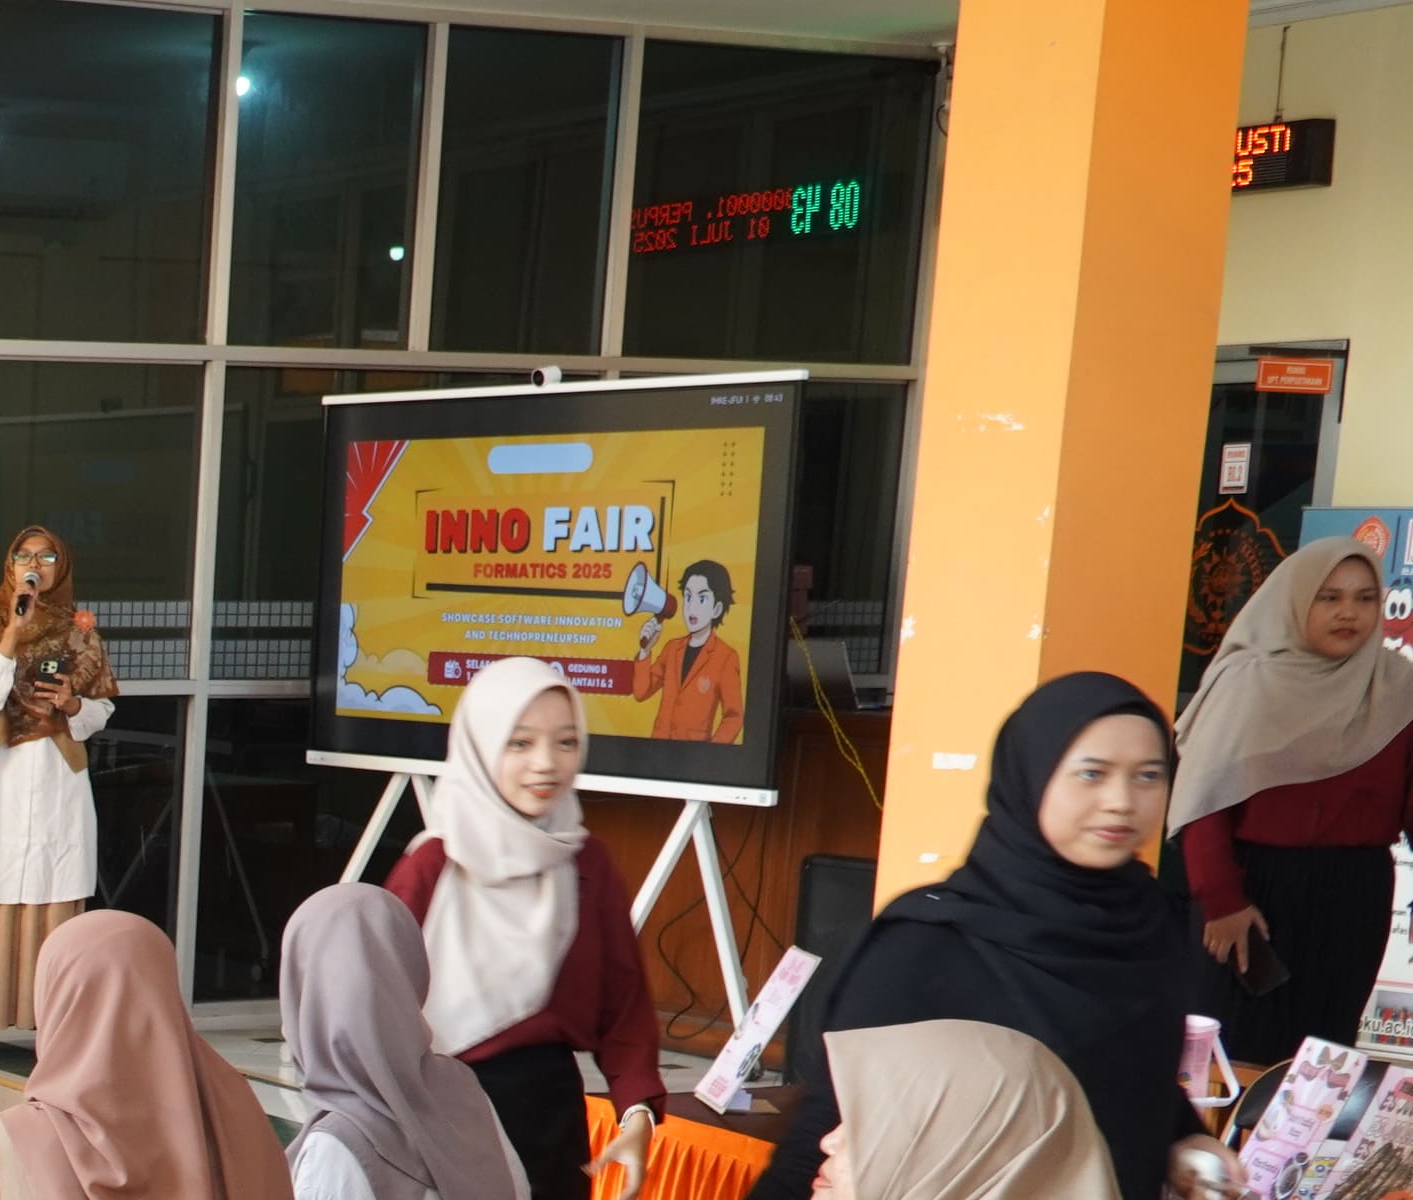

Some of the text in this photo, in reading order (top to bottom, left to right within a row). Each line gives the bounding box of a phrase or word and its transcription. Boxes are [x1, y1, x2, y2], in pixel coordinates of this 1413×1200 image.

[424, 504, 656, 554] INNO FAIR
[473, 562, 613, 580] FORMATICS 2025
[441, 611, 623, 629] SHOWCASE SOFTWARE INNOVATION
[464, 629, 598, 644] AND TECHNOPRENEURSHIP
[567, 663, 608, 674] GEDUNG B
